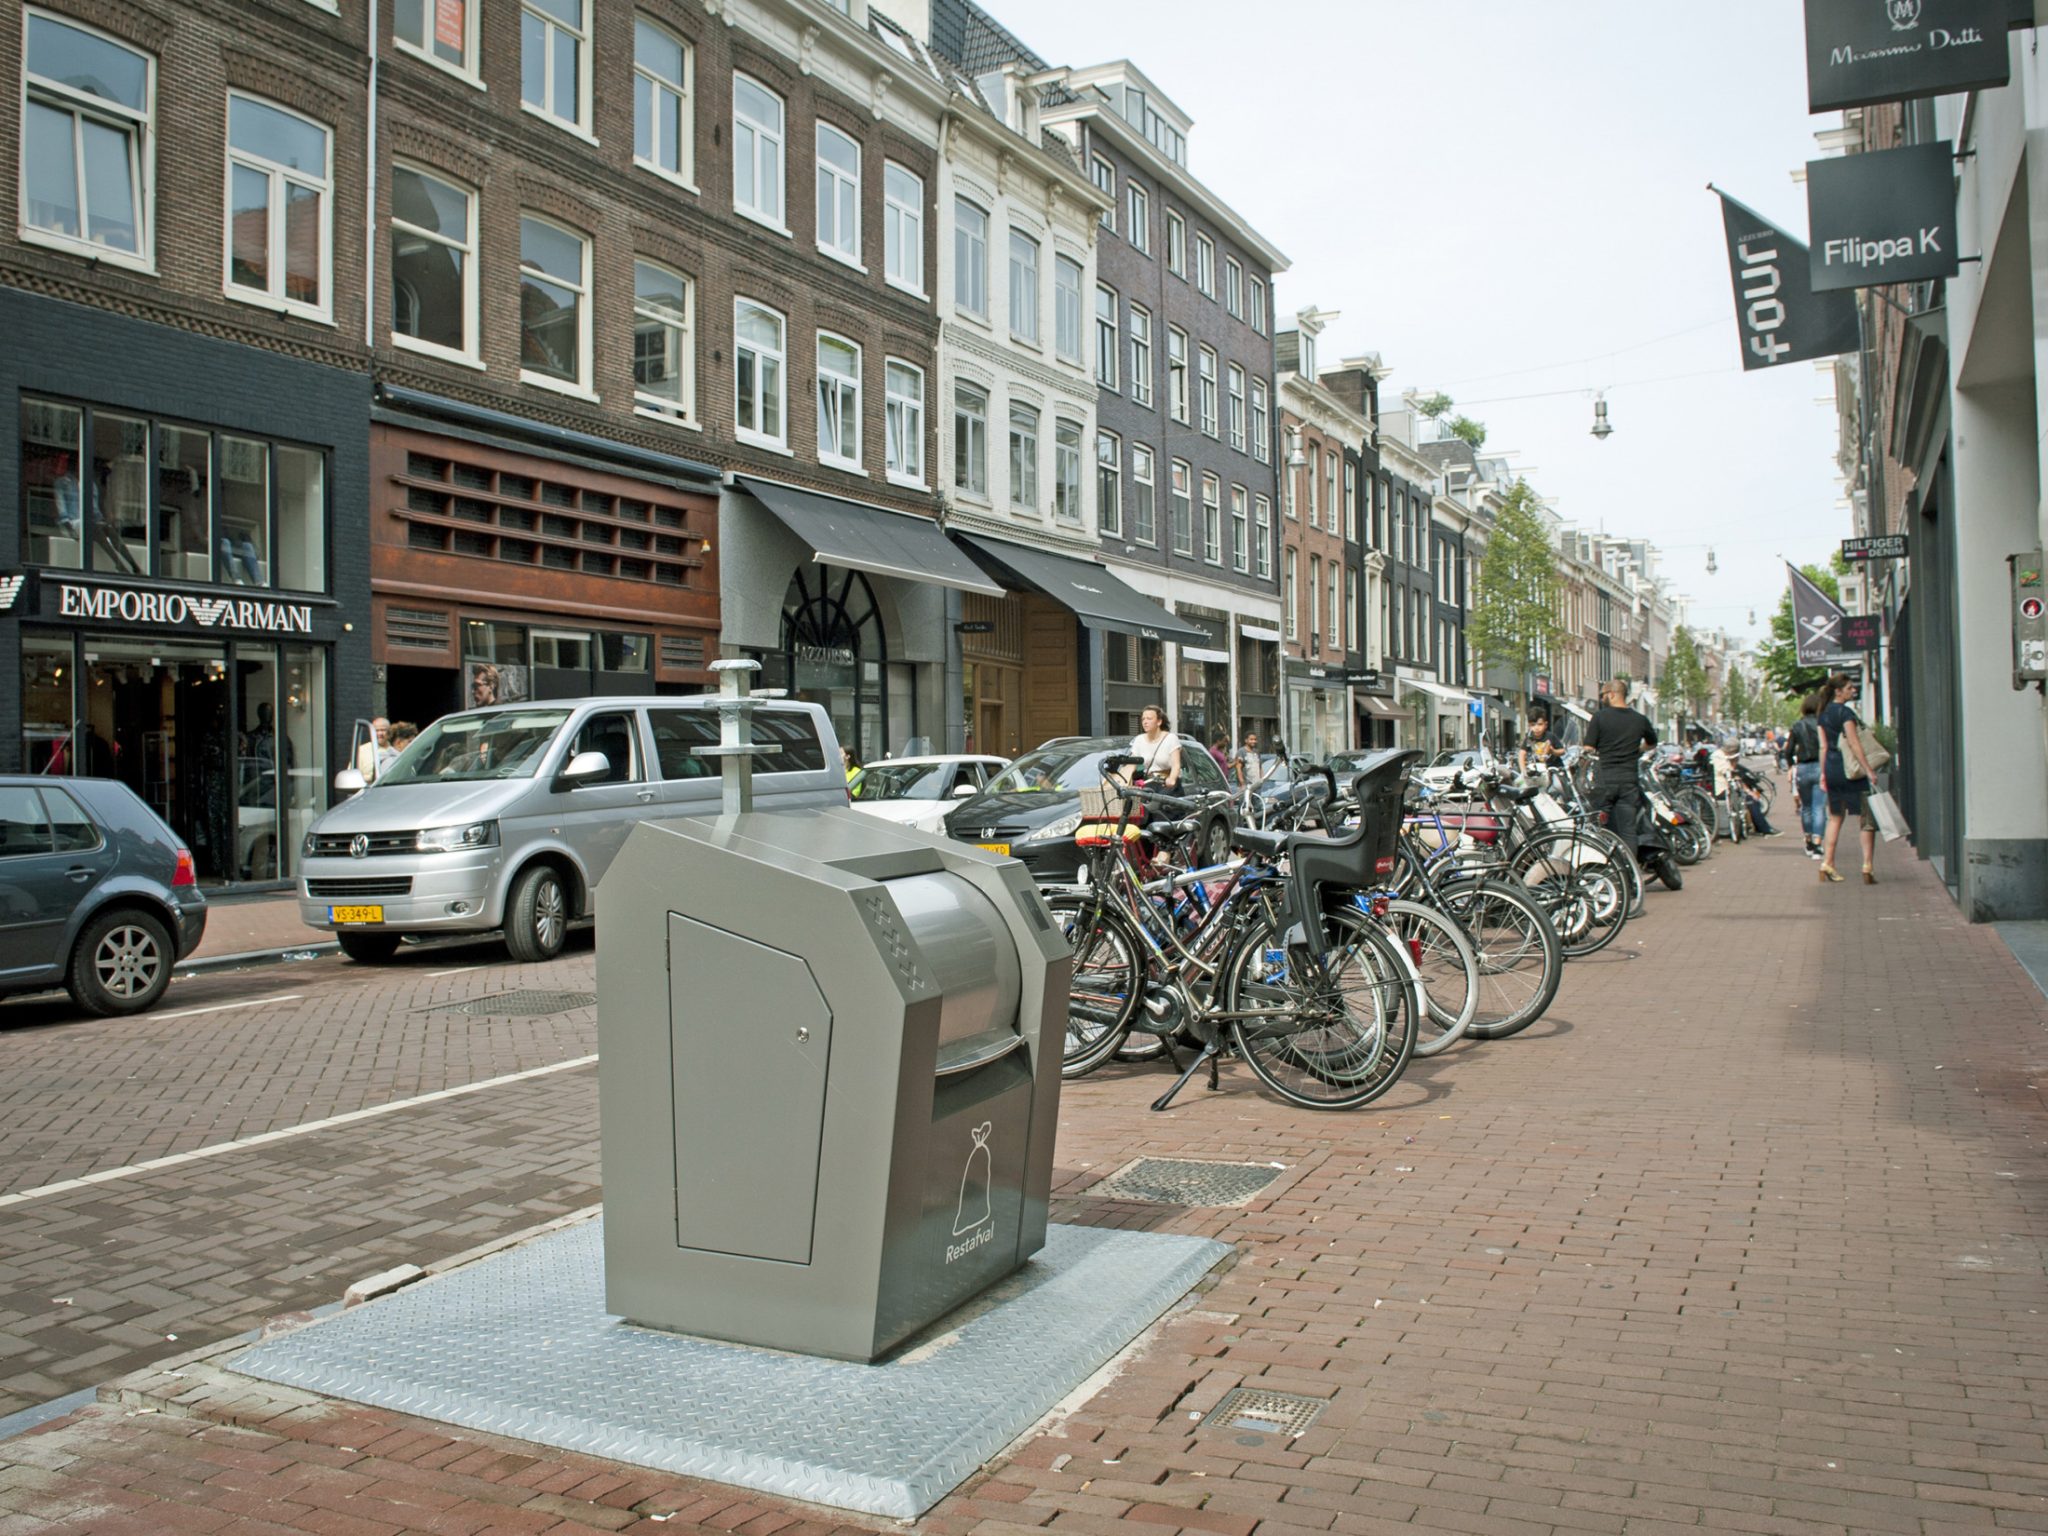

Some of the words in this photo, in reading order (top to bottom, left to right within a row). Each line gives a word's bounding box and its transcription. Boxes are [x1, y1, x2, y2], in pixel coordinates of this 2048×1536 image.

[1830, 44, 1922, 66] Massimo
[1929, 28, 1984, 50] Dutti
[1825, 236, 1913, 267] Filippa
[1920, 226, 1941, 254] K
[1844, 537, 1903, 550] HILFIGER
[1868, 549, 1904, 557] DENIM
[60, 585, 187, 624] EMPORIO
[220, 600, 312, 633] ARMANI
[335, 908, 377, 920] VS-349-L
[945, 1220, 995, 1265] Restafval
